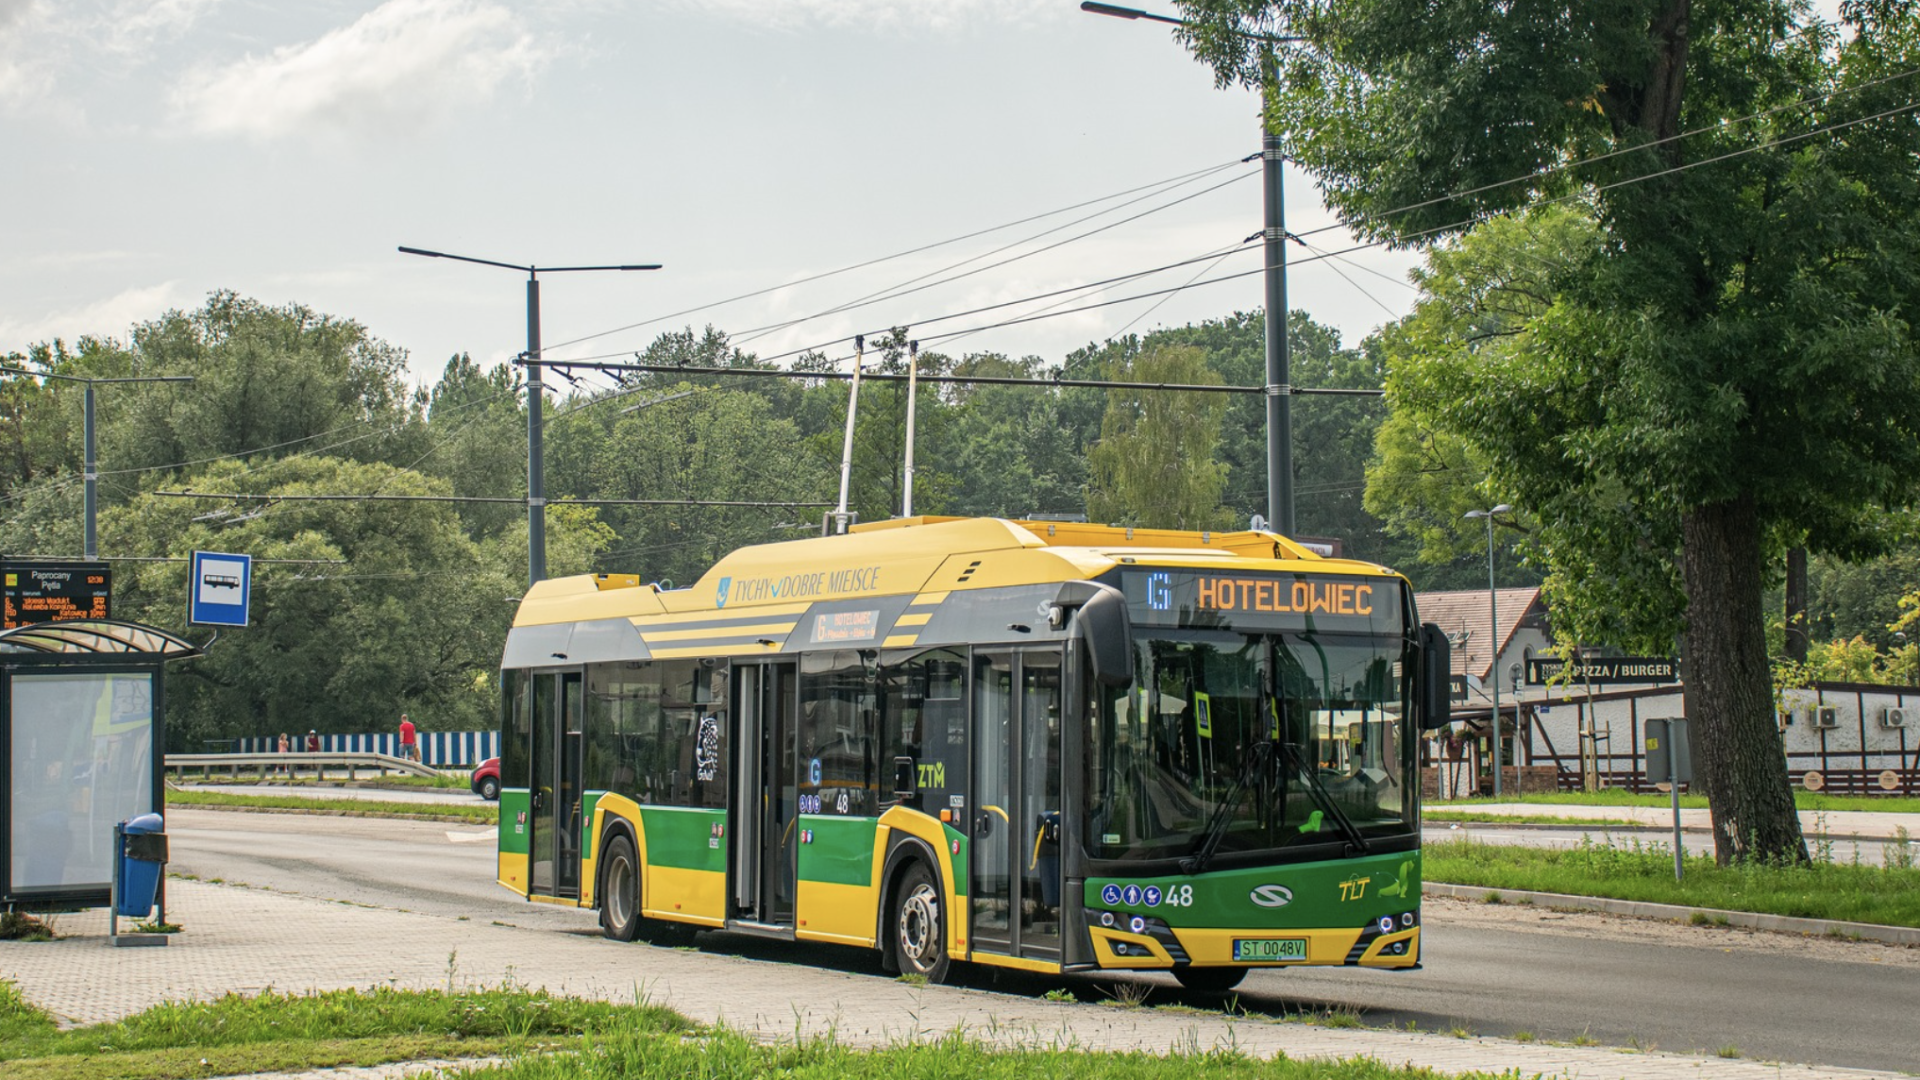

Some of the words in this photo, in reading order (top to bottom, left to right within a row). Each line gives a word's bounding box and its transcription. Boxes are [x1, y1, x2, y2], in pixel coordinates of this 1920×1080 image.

[31, 571, 71, 581] Paprocany
[735, 578, 773, 602] TYCHY
[781, 572, 825, 598] DOBRE
[827, 566, 881, 593] MIEJSCE
[1199, 578, 1373, 615] HOTELOWIEC
[817, 614, 826, 641] G
[1571, 665, 1610, 677] PIZZA
[1621, 664, 1671, 677] BURGER
[810, 758, 822, 786] G
[917, 761, 945, 789] ZTM
[836, 794, 849, 814] 48
[1165, 885, 1193, 907] 48
[1339, 877, 1370, 901] TLT
[1242, 941, 1259, 956] ST
[1263, 941, 1302, 956] 0048V
